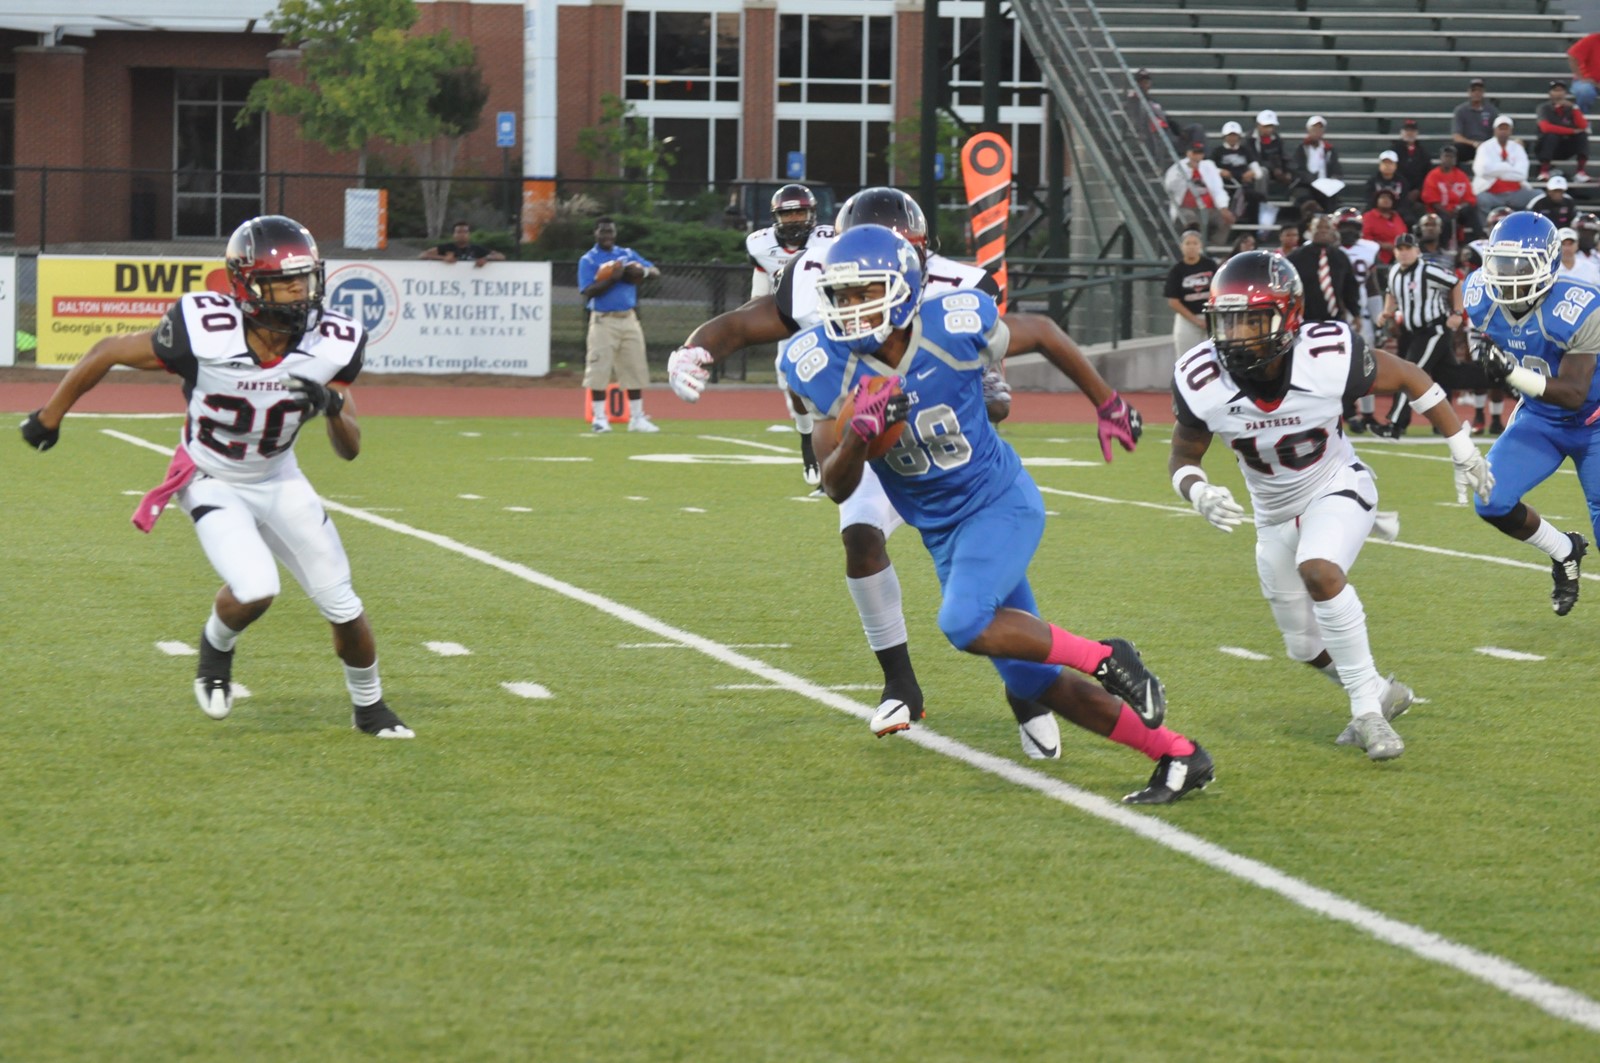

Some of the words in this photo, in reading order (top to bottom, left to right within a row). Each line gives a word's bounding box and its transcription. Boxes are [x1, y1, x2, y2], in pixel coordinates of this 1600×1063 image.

[115, 263, 203, 293] DWF
[402, 279, 466, 298] TOLES,
[470, 280, 544, 297] TEMPLE
[928, 274, 963, 287] 1
[57, 301, 100, 313] DALTON
[102, 301, 164, 314] WHOLESALE
[192, 295, 238, 333] 20
[402, 303, 416, 320] &
[424, 303, 505, 323] WRIGHT,
[511, 304, 544, 322] INC
[942, 292, 983, 335] 88
[1552, 286, 1596, 326] 22
[52, 321, 113, 335] Georgia's
[419, 326, 464, 337] REAL
[470, 326, 527, 337] ESTATE
[1307, 322, 1346, 359] 10
[786, 332, 829, 383] 88
[1179, 347, 1221, 392] 10
[197, 393, 306, 461] 20
[884, 403, 973, 477] 88
[1244, 416, 1302, 431] PANTHERS
[1231, 427, 1330, 476] 10
